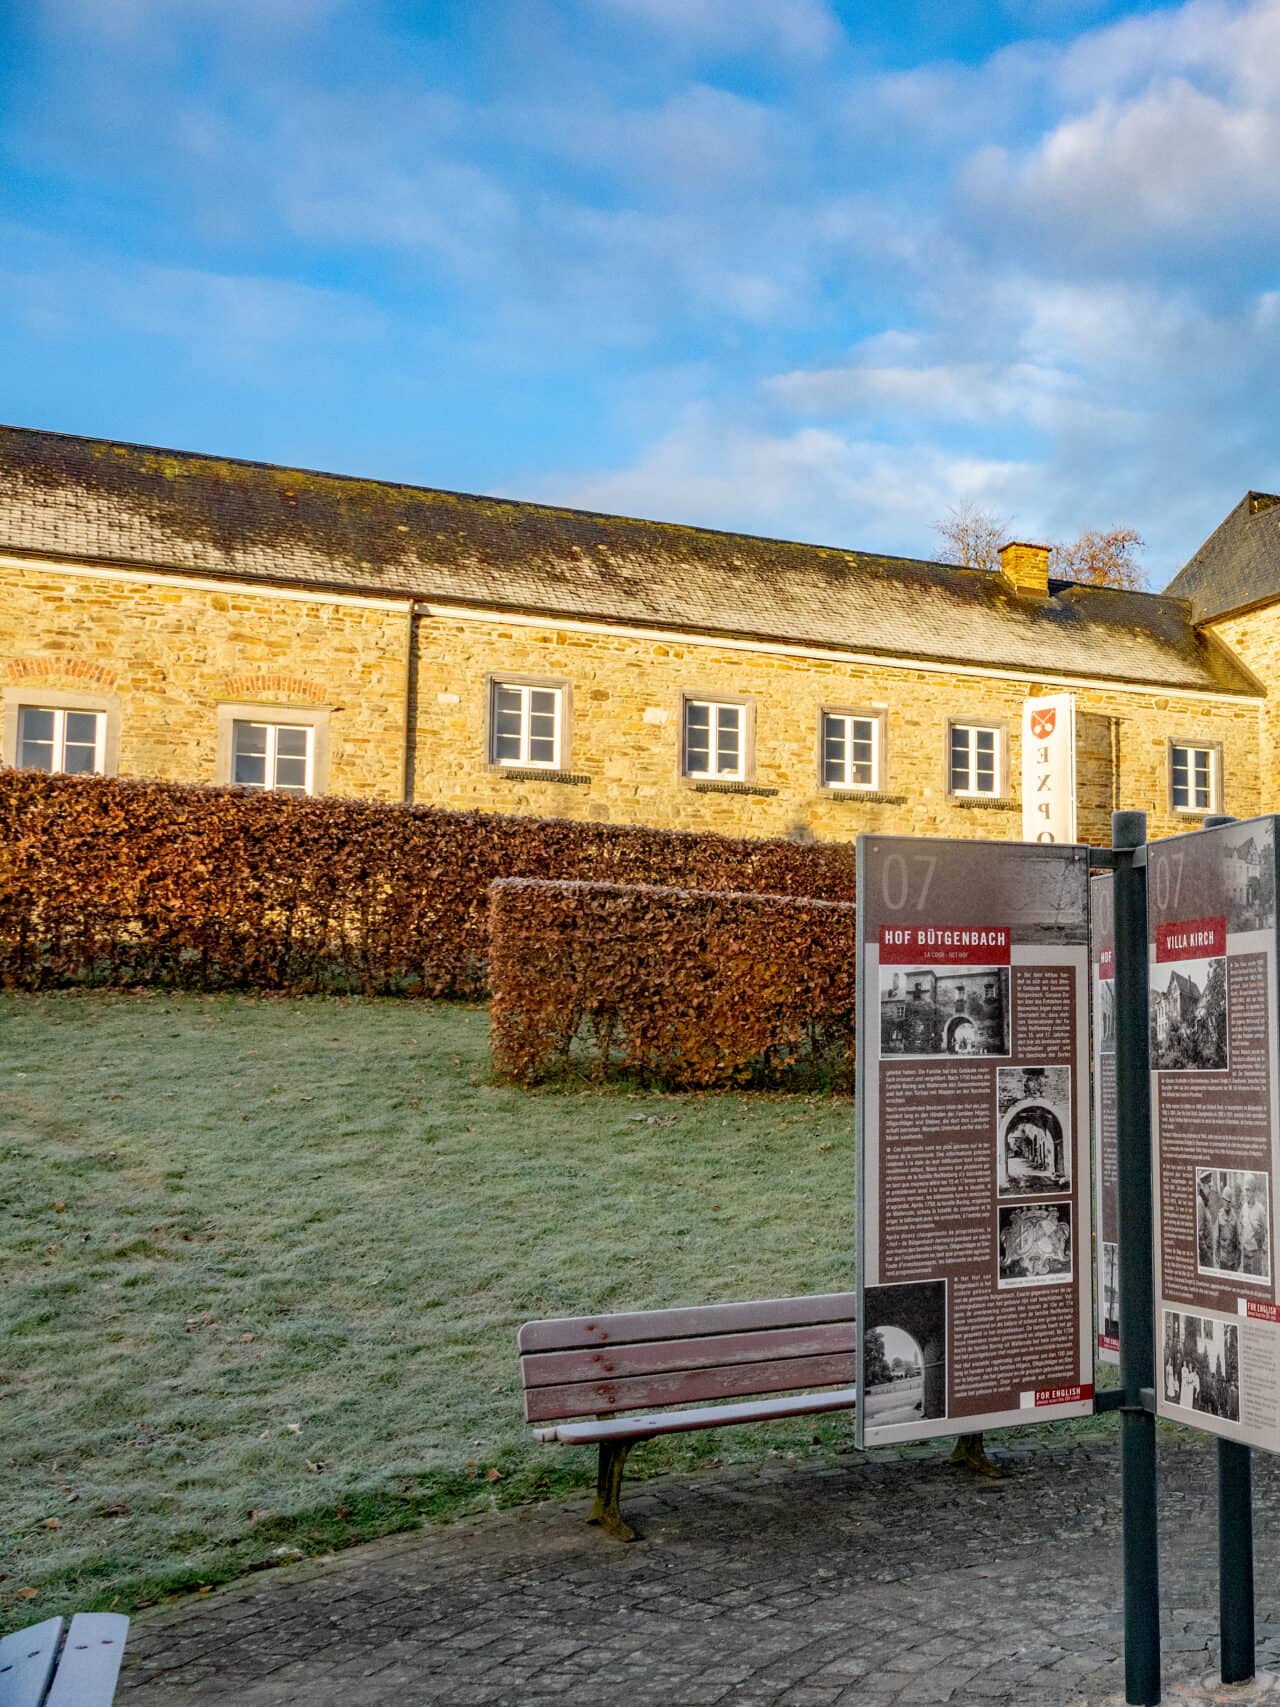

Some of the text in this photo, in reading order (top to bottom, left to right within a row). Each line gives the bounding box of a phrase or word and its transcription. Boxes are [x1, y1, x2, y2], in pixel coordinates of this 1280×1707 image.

[882, 854, 937, 911] 07
[1156, 852, 1185, 911] 07
[885, 928, 1006, 946] HOF BÜTGENBACH
[1166, 930, 1214, 950] VILLA KIRCH
[1036, 1386, 1081, 1400] FOR ENGLISH
